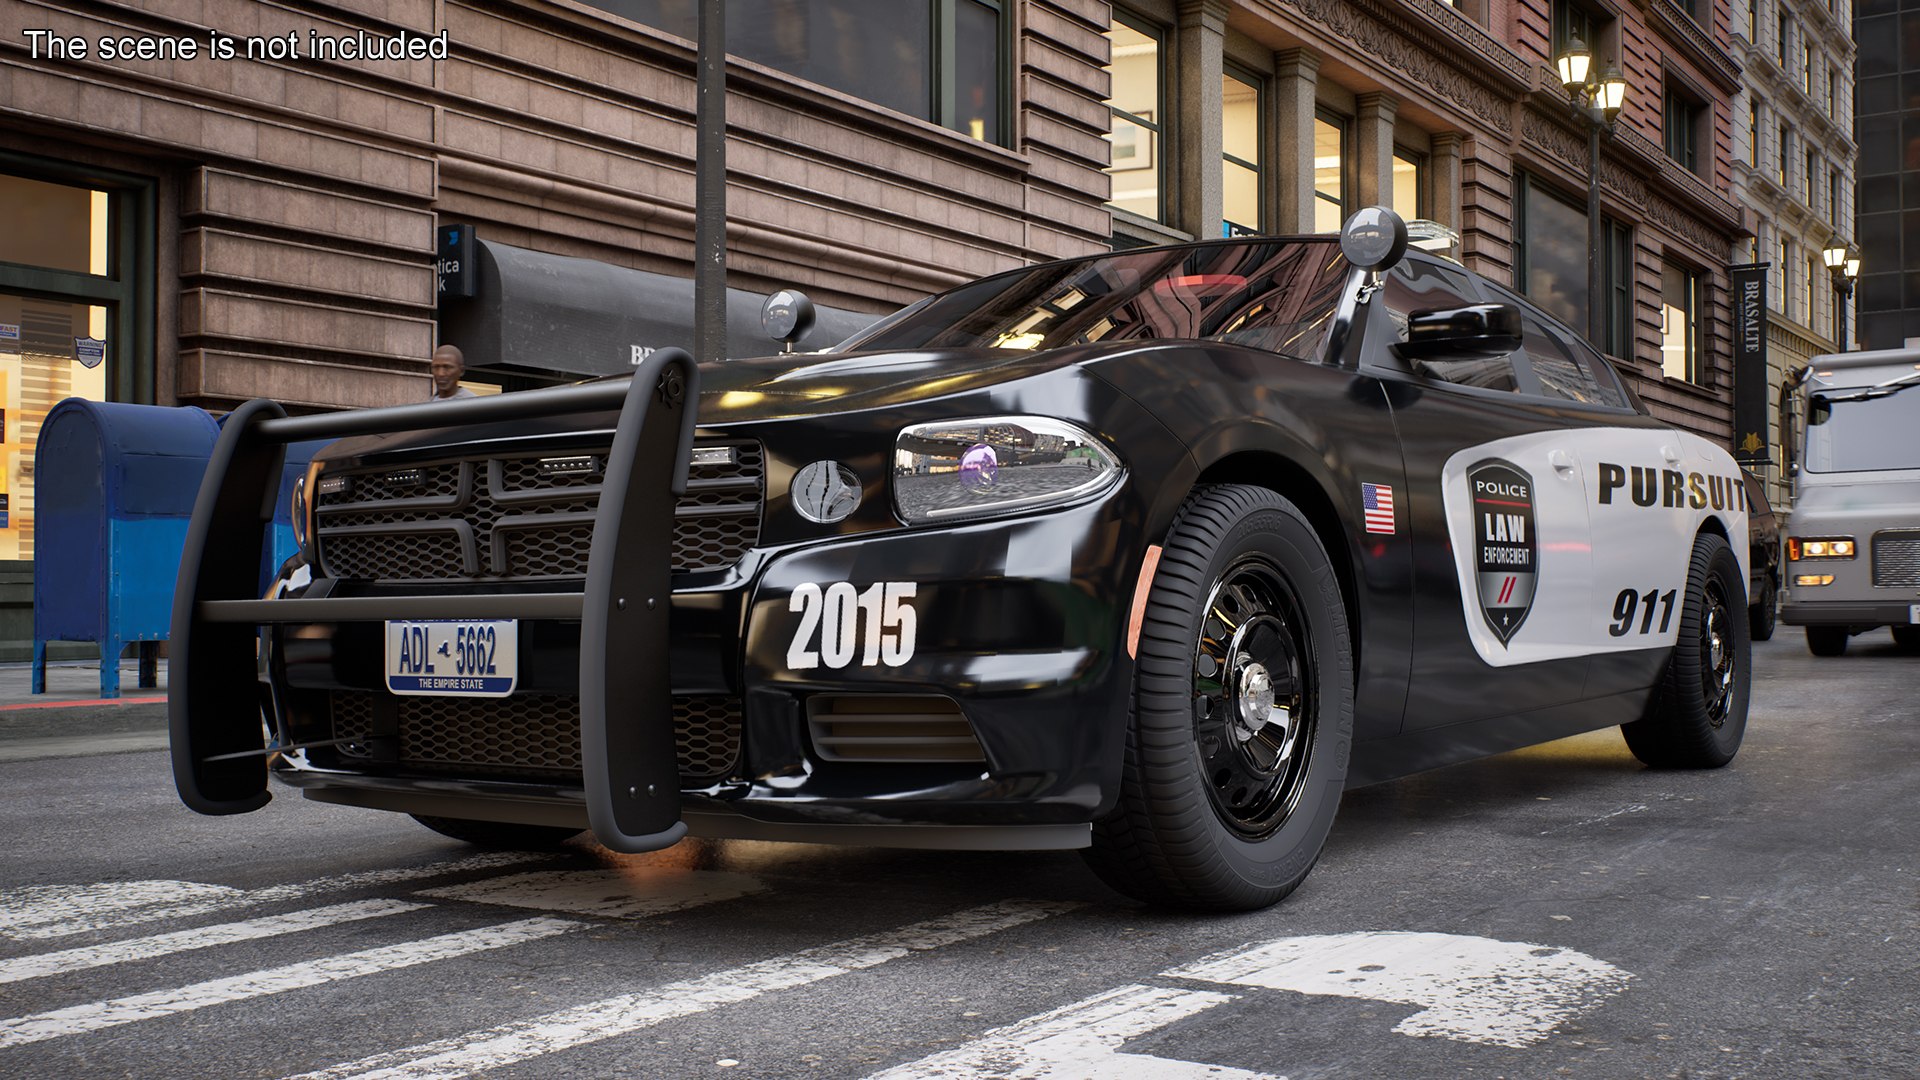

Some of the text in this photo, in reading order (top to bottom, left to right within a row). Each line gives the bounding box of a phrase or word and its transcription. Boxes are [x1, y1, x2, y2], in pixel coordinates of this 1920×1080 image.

[1745, 280, 1759, 353] BRASALTE
[1476, 480, 1527, 498] POLICE
[1598, 462, 1744, 512] PURSUIT
[1485, 513, 1525, 543] LAW
[1484, 547, 1530, 565] ENFORCEMENT
[786, 581, 918, 670] 2015
[1608, 588, 1677, 637] 911
[399, 625, 497, 675] ADL 5662
[1329, 605, 1353, 738] MICHELIN
[419, 678, 484, 690] THE EMPIRE STATE
